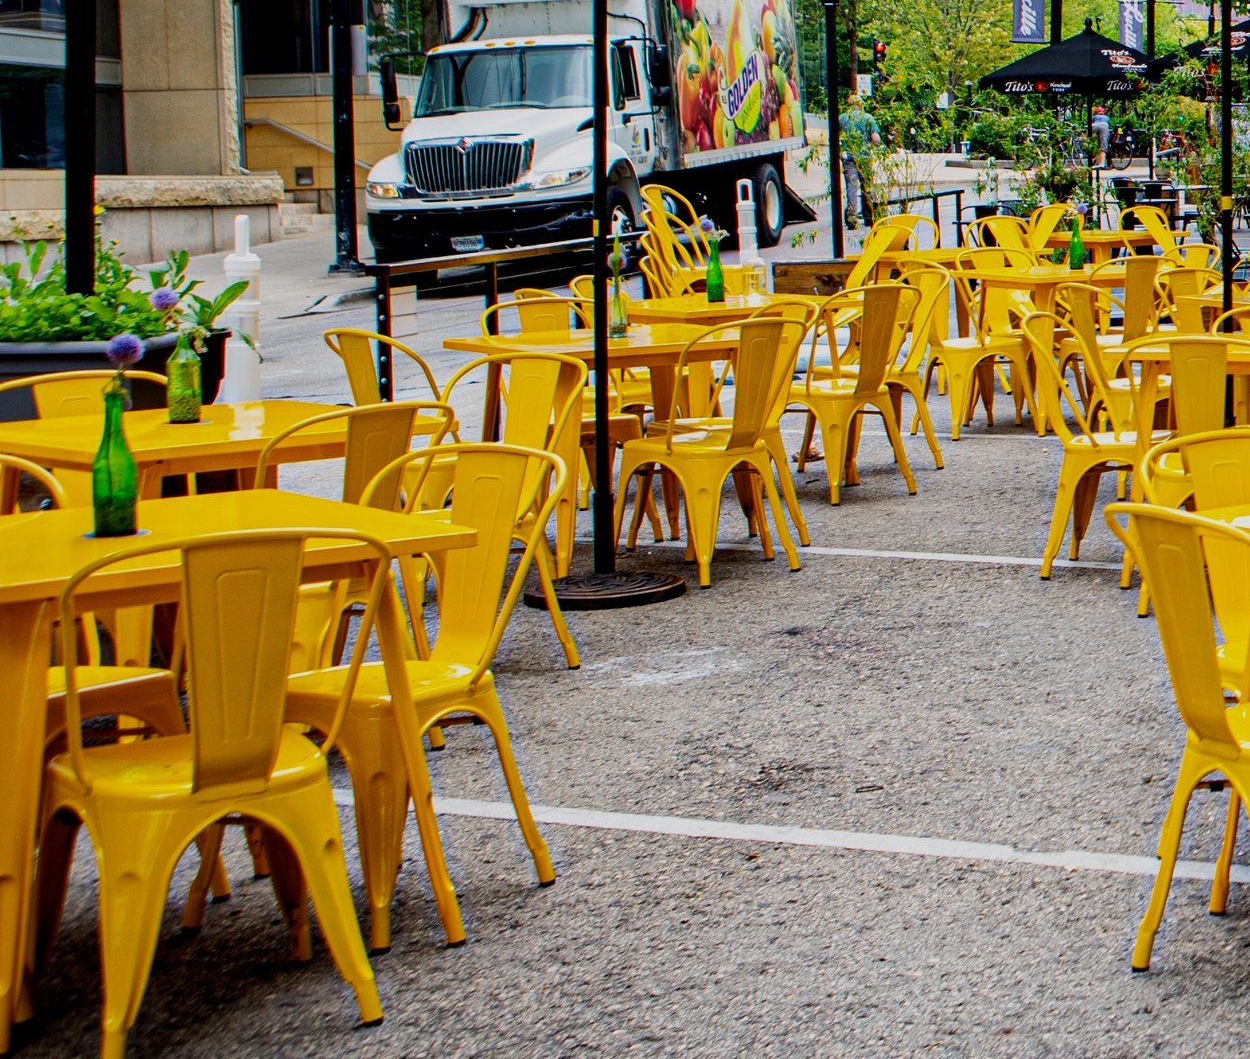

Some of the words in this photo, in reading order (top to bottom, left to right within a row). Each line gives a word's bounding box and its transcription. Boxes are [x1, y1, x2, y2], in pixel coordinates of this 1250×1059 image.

[728, 53, 758, 117] GOLDEN
[1004, 81, 1034, 92] Tito's
[1107, 80, 1133, 91] Tito's
